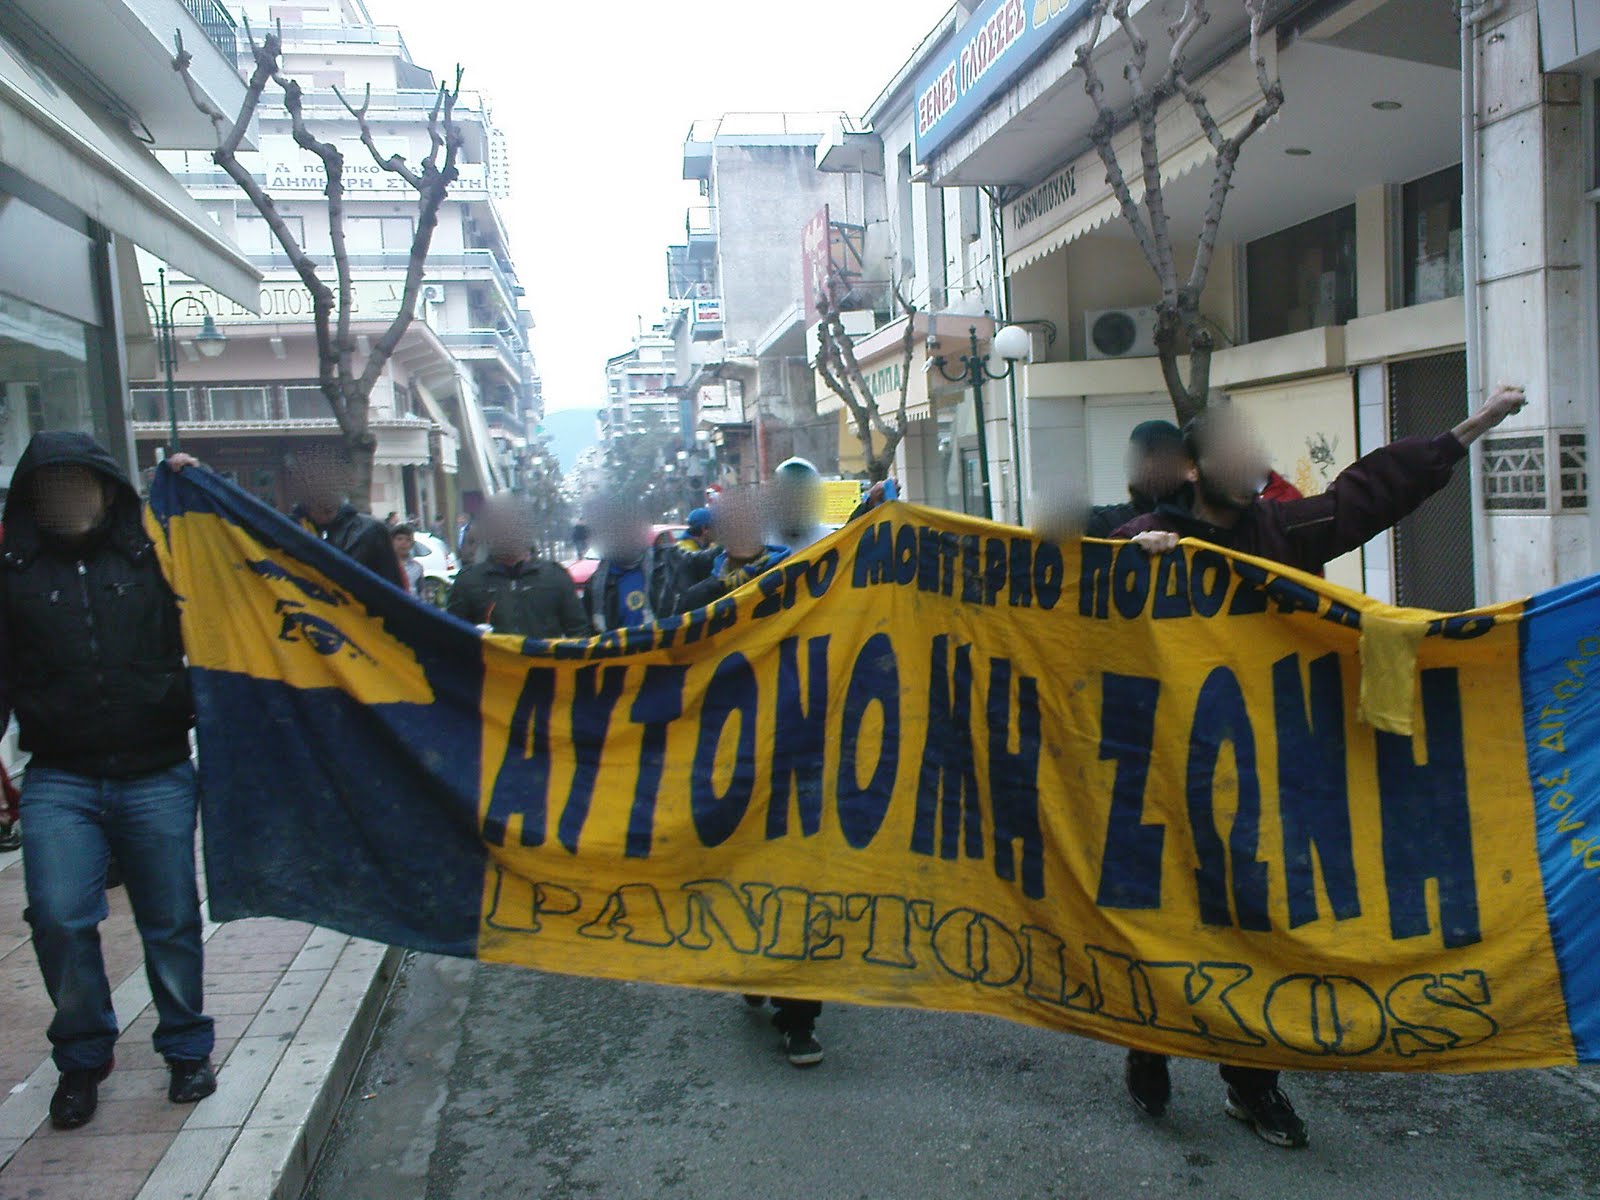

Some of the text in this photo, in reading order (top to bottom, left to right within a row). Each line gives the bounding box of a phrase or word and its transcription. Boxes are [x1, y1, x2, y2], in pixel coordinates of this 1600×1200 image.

[919, 0, 1026, 136] ΞΕΝΕΣ ΓΛΩΣΣΕΣ
[272, 177, 482, 189] ΔΗΜΗΡΗ ΣΤΤΗ
[303, 165, 380, 174] ΠΟΤΙΚΟ
[186, 287, 359, 316] ΑΓΟΠΟΥΟΣ
[752, 547, 839, 619] ΣΤΟ
[852, 520, 1064, 610] ΜΟΝΤΕΡΝΟ
[482, 632, 1483, 950] ΑΥΤΟΝΟΜΗ ΖΩΝΗ
[485, 865, 1498, 1058] PANETOLIKOS
